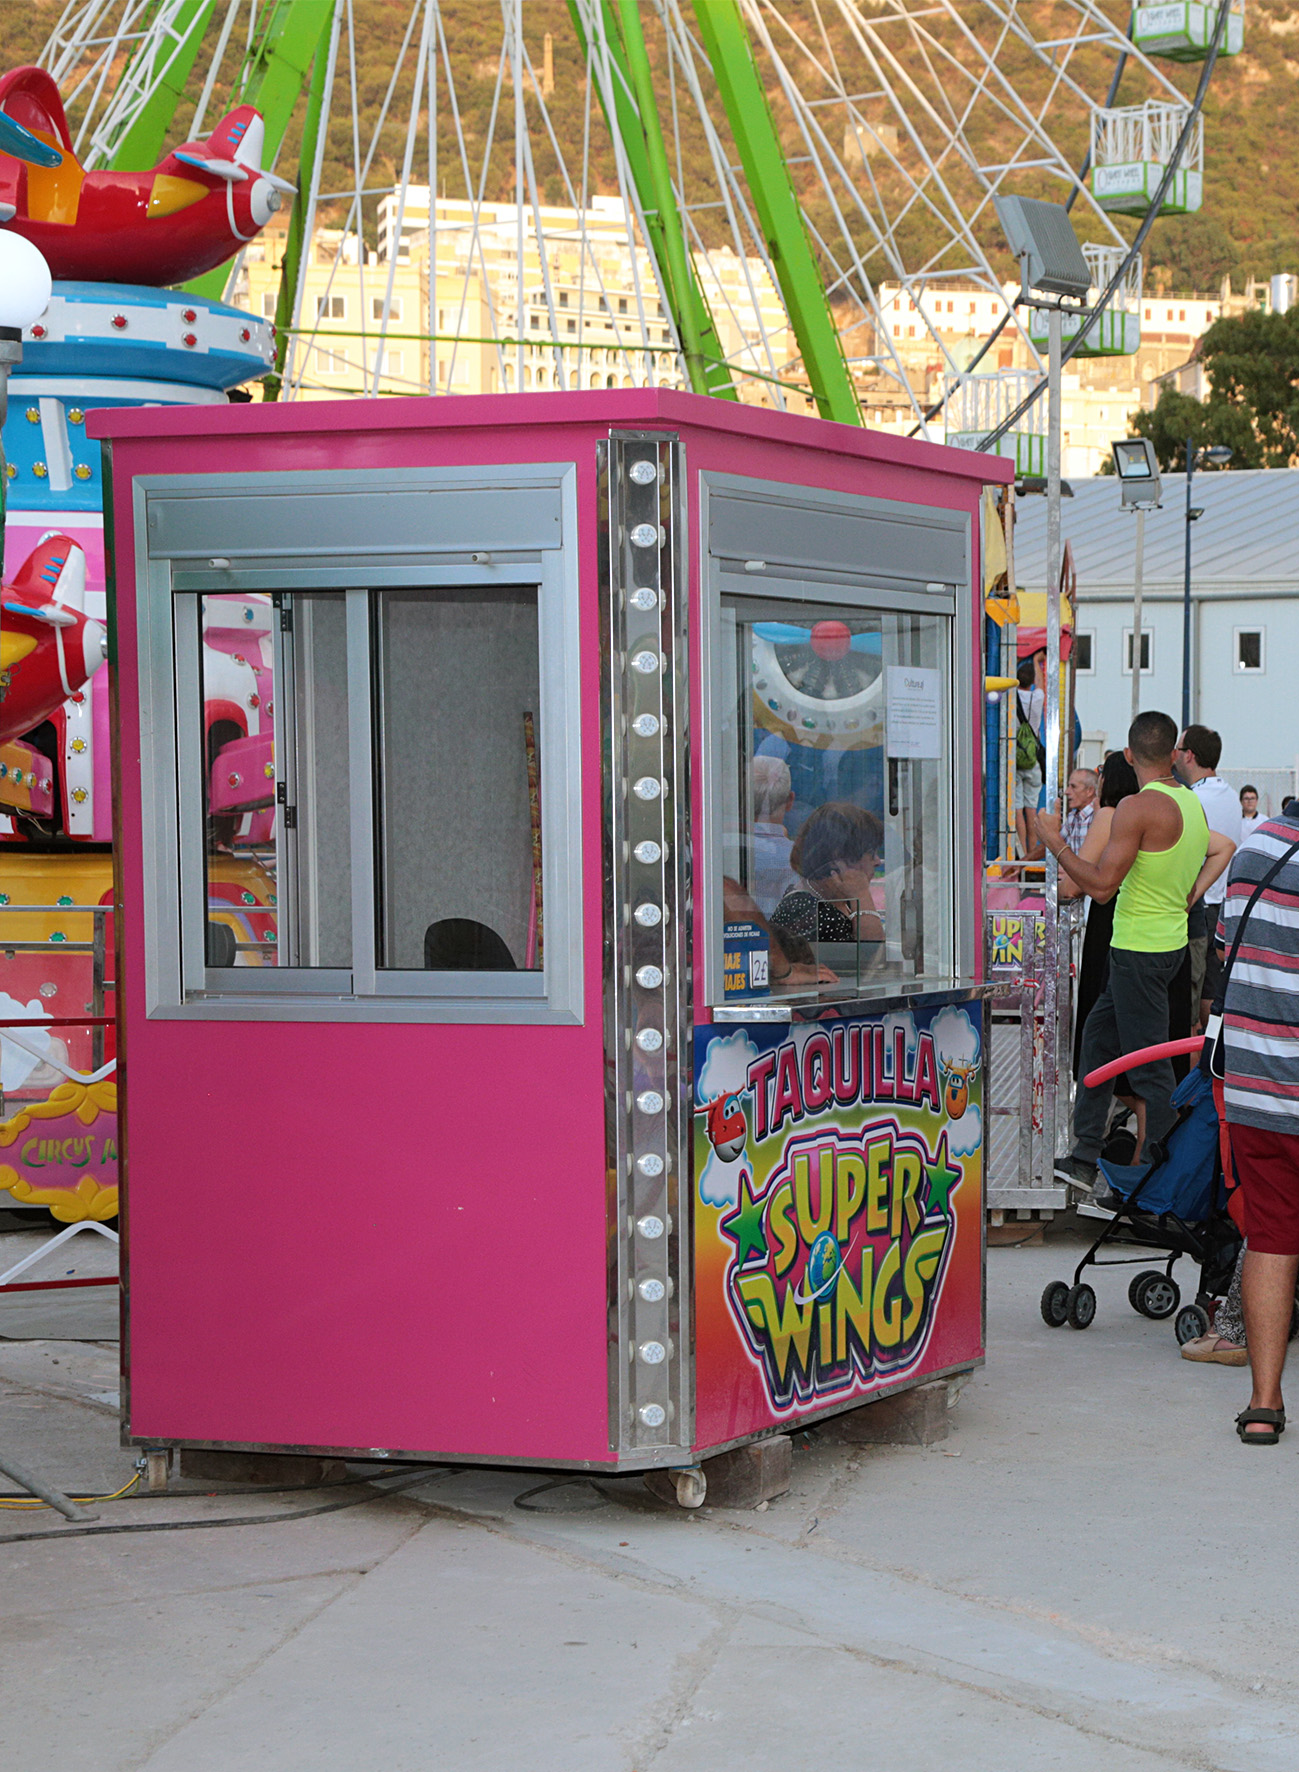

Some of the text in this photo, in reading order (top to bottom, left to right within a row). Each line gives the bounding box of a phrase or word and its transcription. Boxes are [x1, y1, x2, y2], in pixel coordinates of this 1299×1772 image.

[992, 917, 1046, 940] UPR
[724, 952, 741, 969] IAJE
[724, 973, 746, 990] IAJES
[747, 1025, 940, 1142] TAQUILLA
[21, 1135, 95, 1168] CIRCUS
[769, 1139, 922, 1277] SUPER
[737, 1225, 949, 1387] WINGS
